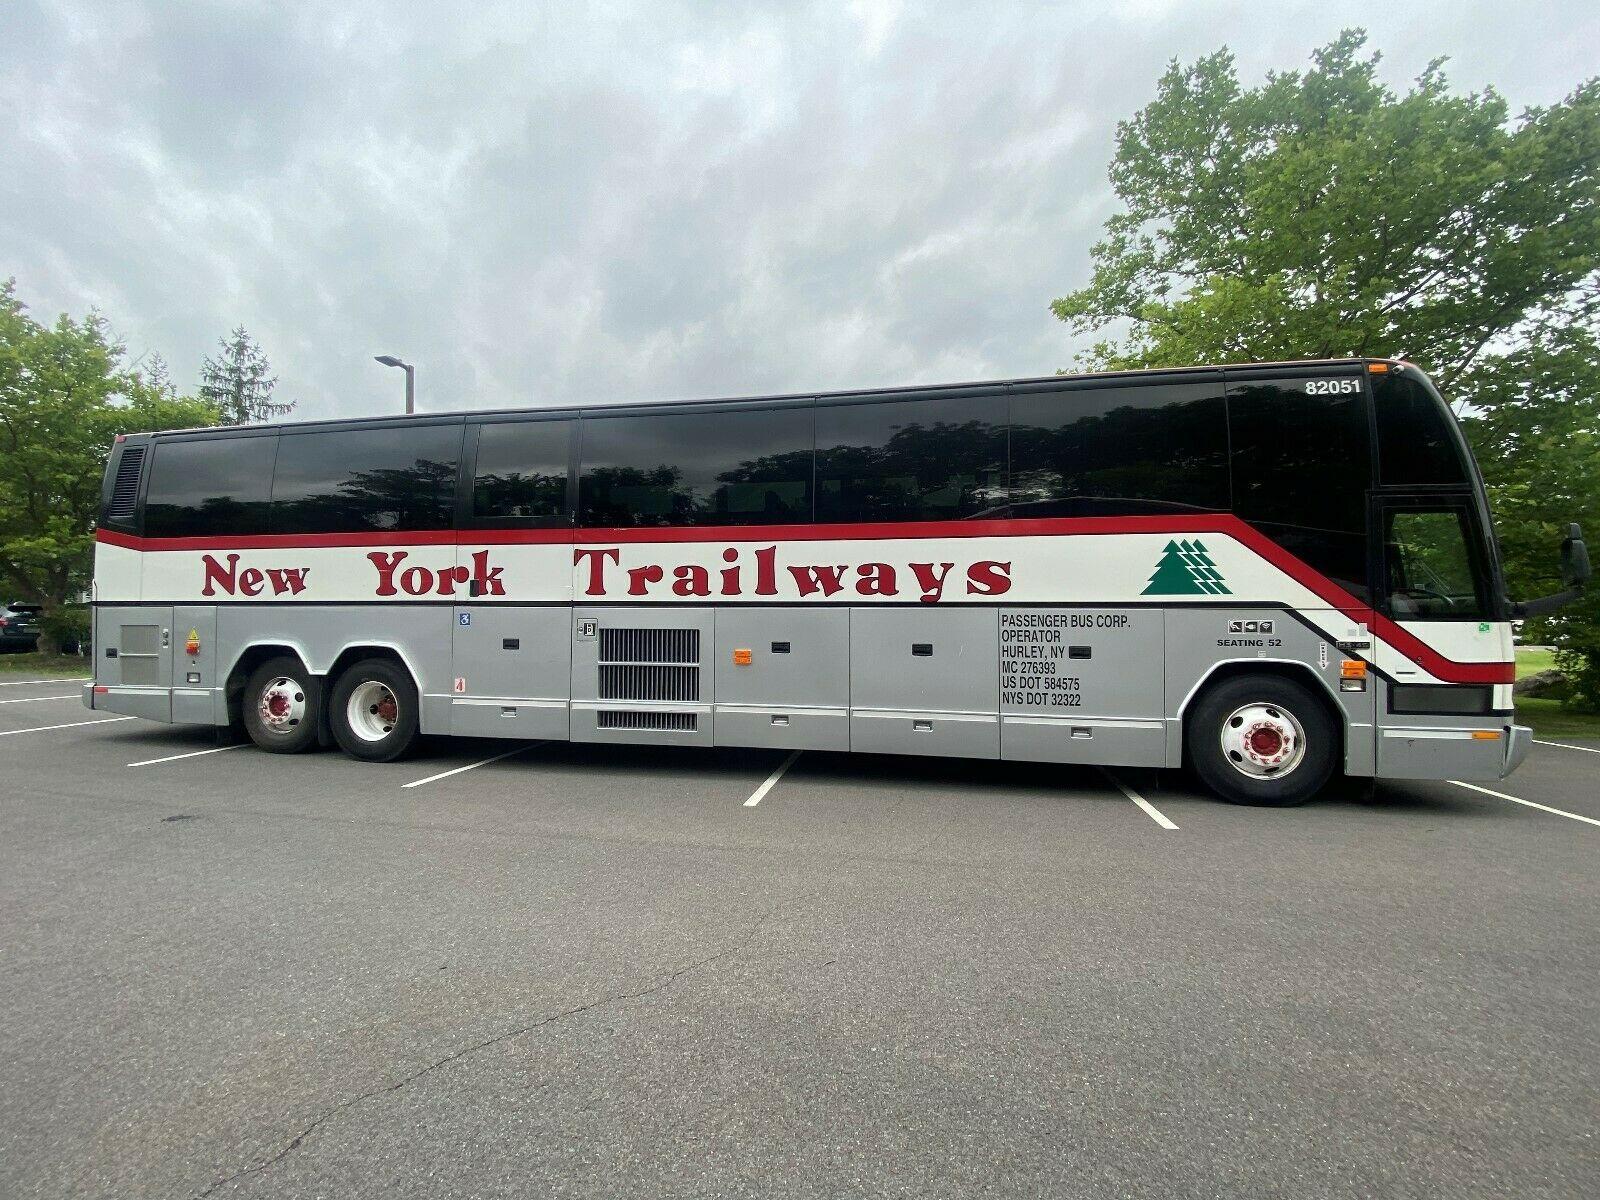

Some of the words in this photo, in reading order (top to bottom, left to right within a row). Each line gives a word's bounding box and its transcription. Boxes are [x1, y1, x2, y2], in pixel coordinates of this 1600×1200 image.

[1305, 380, 1361, 395] 82051
[201, 553, 311, 597] New
[366, 550, 506, 597] York
[573, 545, 1012, 603] Trailways
[1001, 614, 1068, 628] PASSENGER
[1070, 615, 1093, 627] BUS
[1096, 615, 1131, 628] CORP.
[1001, 630, 1061, 643] OPERATOR
[1217, 639, 1264, 647] SEATING
[1268, 639, 1282, 647] 52
[1002, 646, 1048, 661] HURLEY,
[1051, 647, 1065, 659] NY
[1002, 661, 1018, 673] MC
[1020, 662, 1056, 674] 276393
[1002, 676, 1017, 689] US
[1019, 676, 1041, 689] DOT
[1044, 677, 1080, 690] 584575
[1002, 692, 1024, 705] NYS
[1026, 692, 1048, 705] DOT
[1051, 693, 1081, 706] 32322
